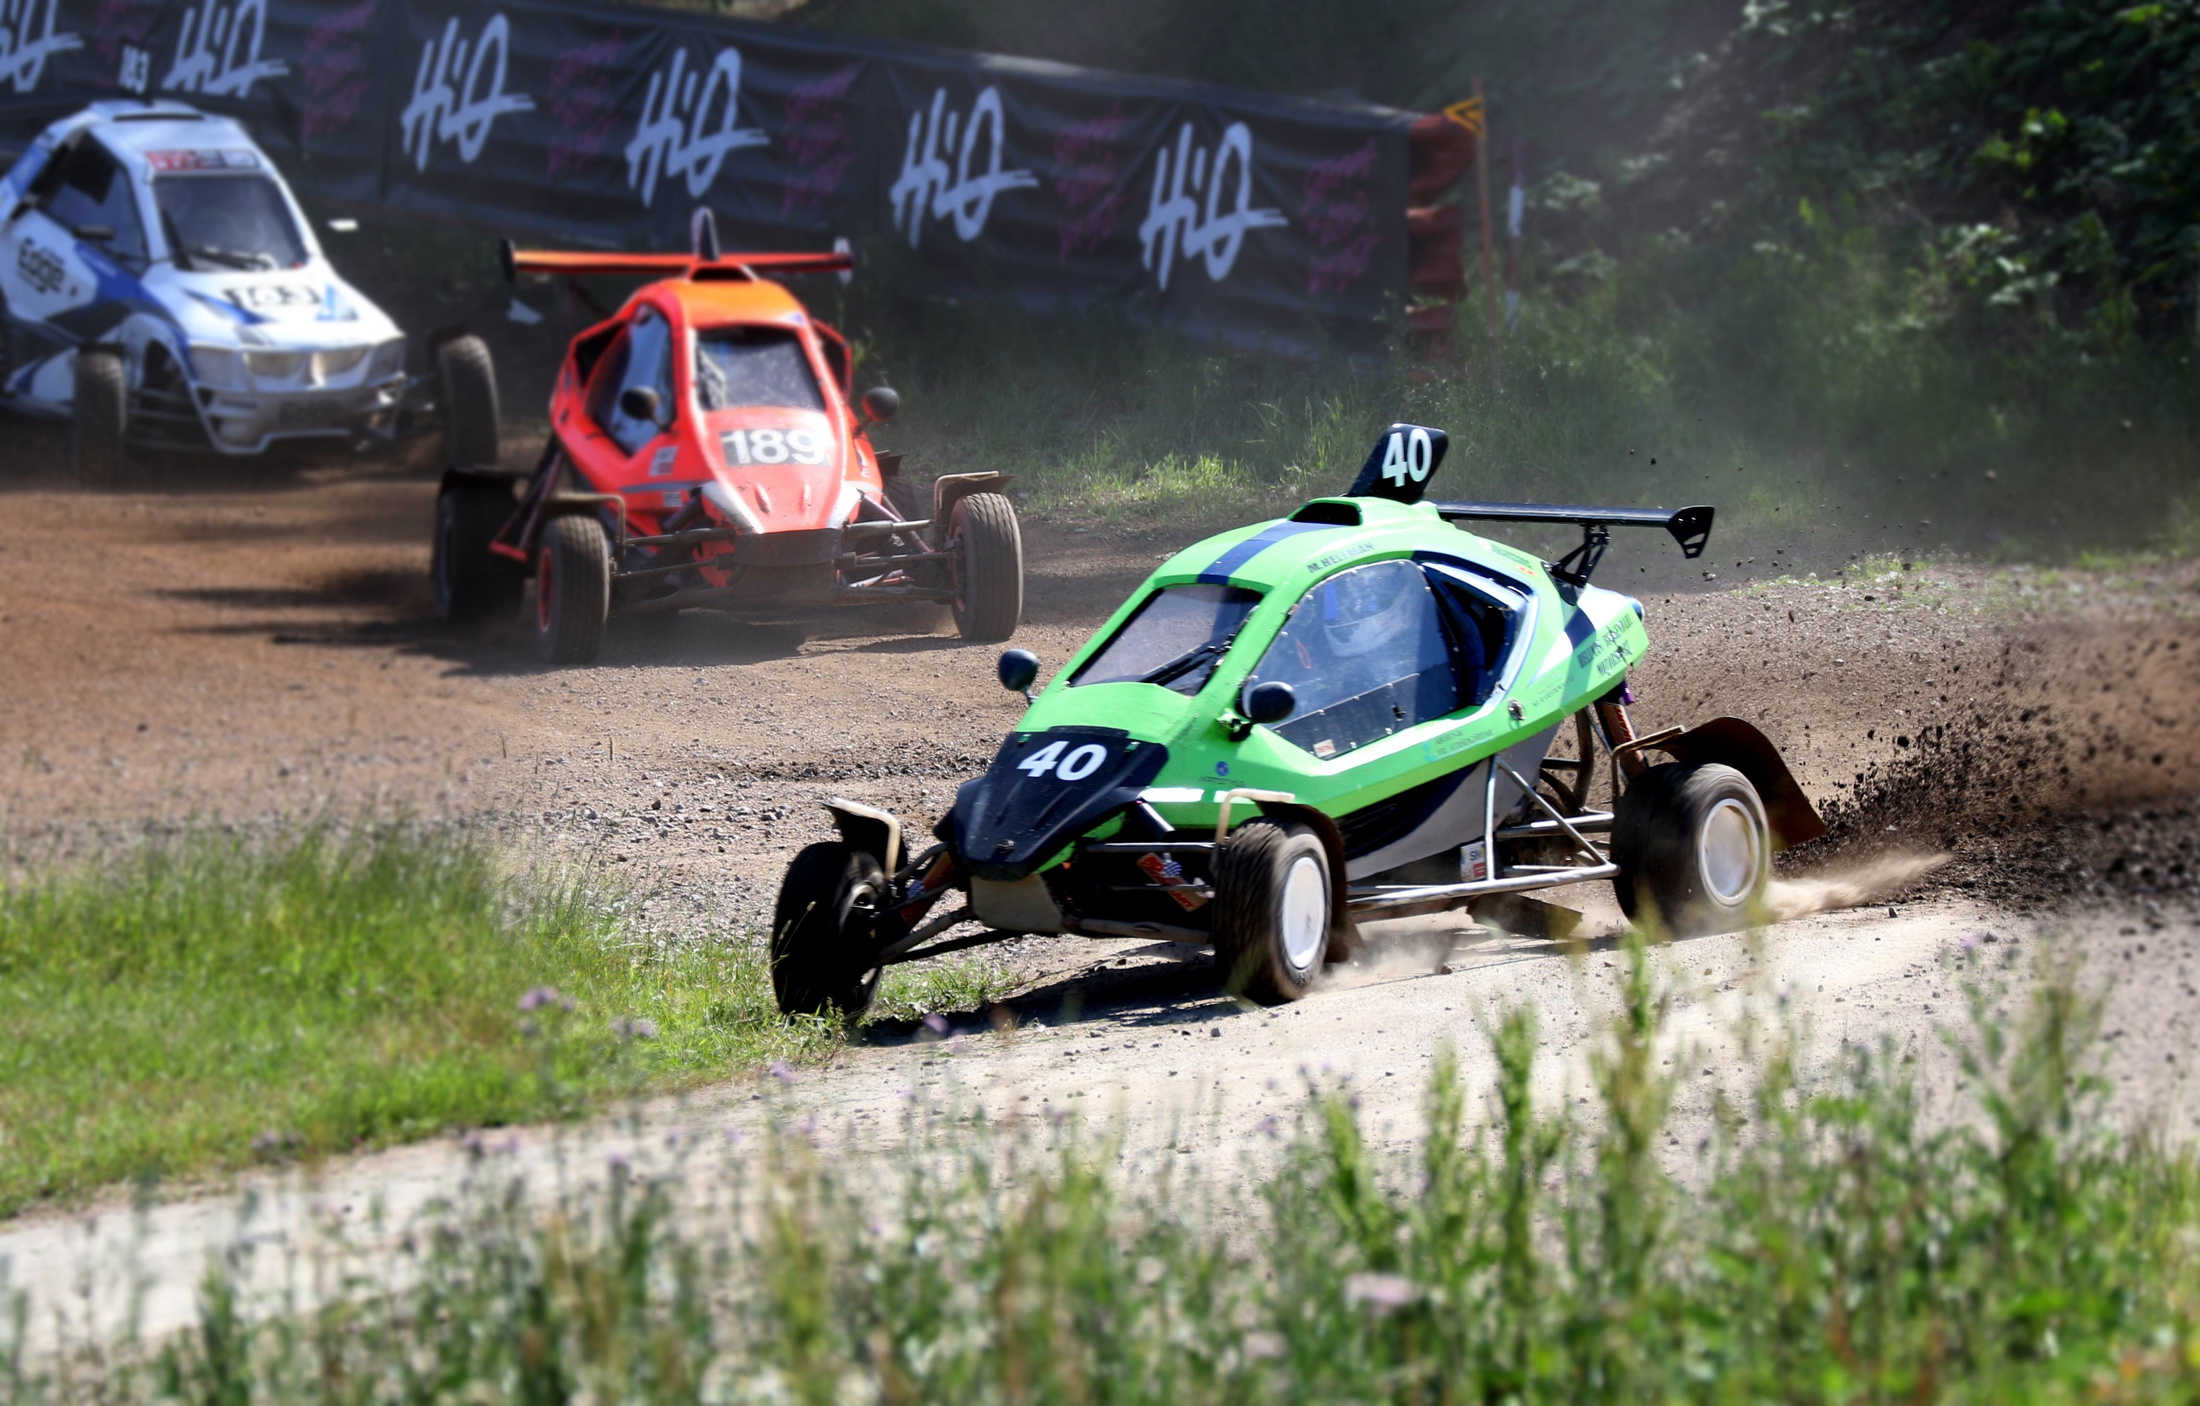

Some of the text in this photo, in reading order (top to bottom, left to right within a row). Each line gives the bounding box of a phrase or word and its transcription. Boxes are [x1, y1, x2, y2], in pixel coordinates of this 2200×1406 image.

[720, 428, 827, 465] 189
[1381, 428, 1433, 487] 40
[1016, 740, 1107, 781] 40
